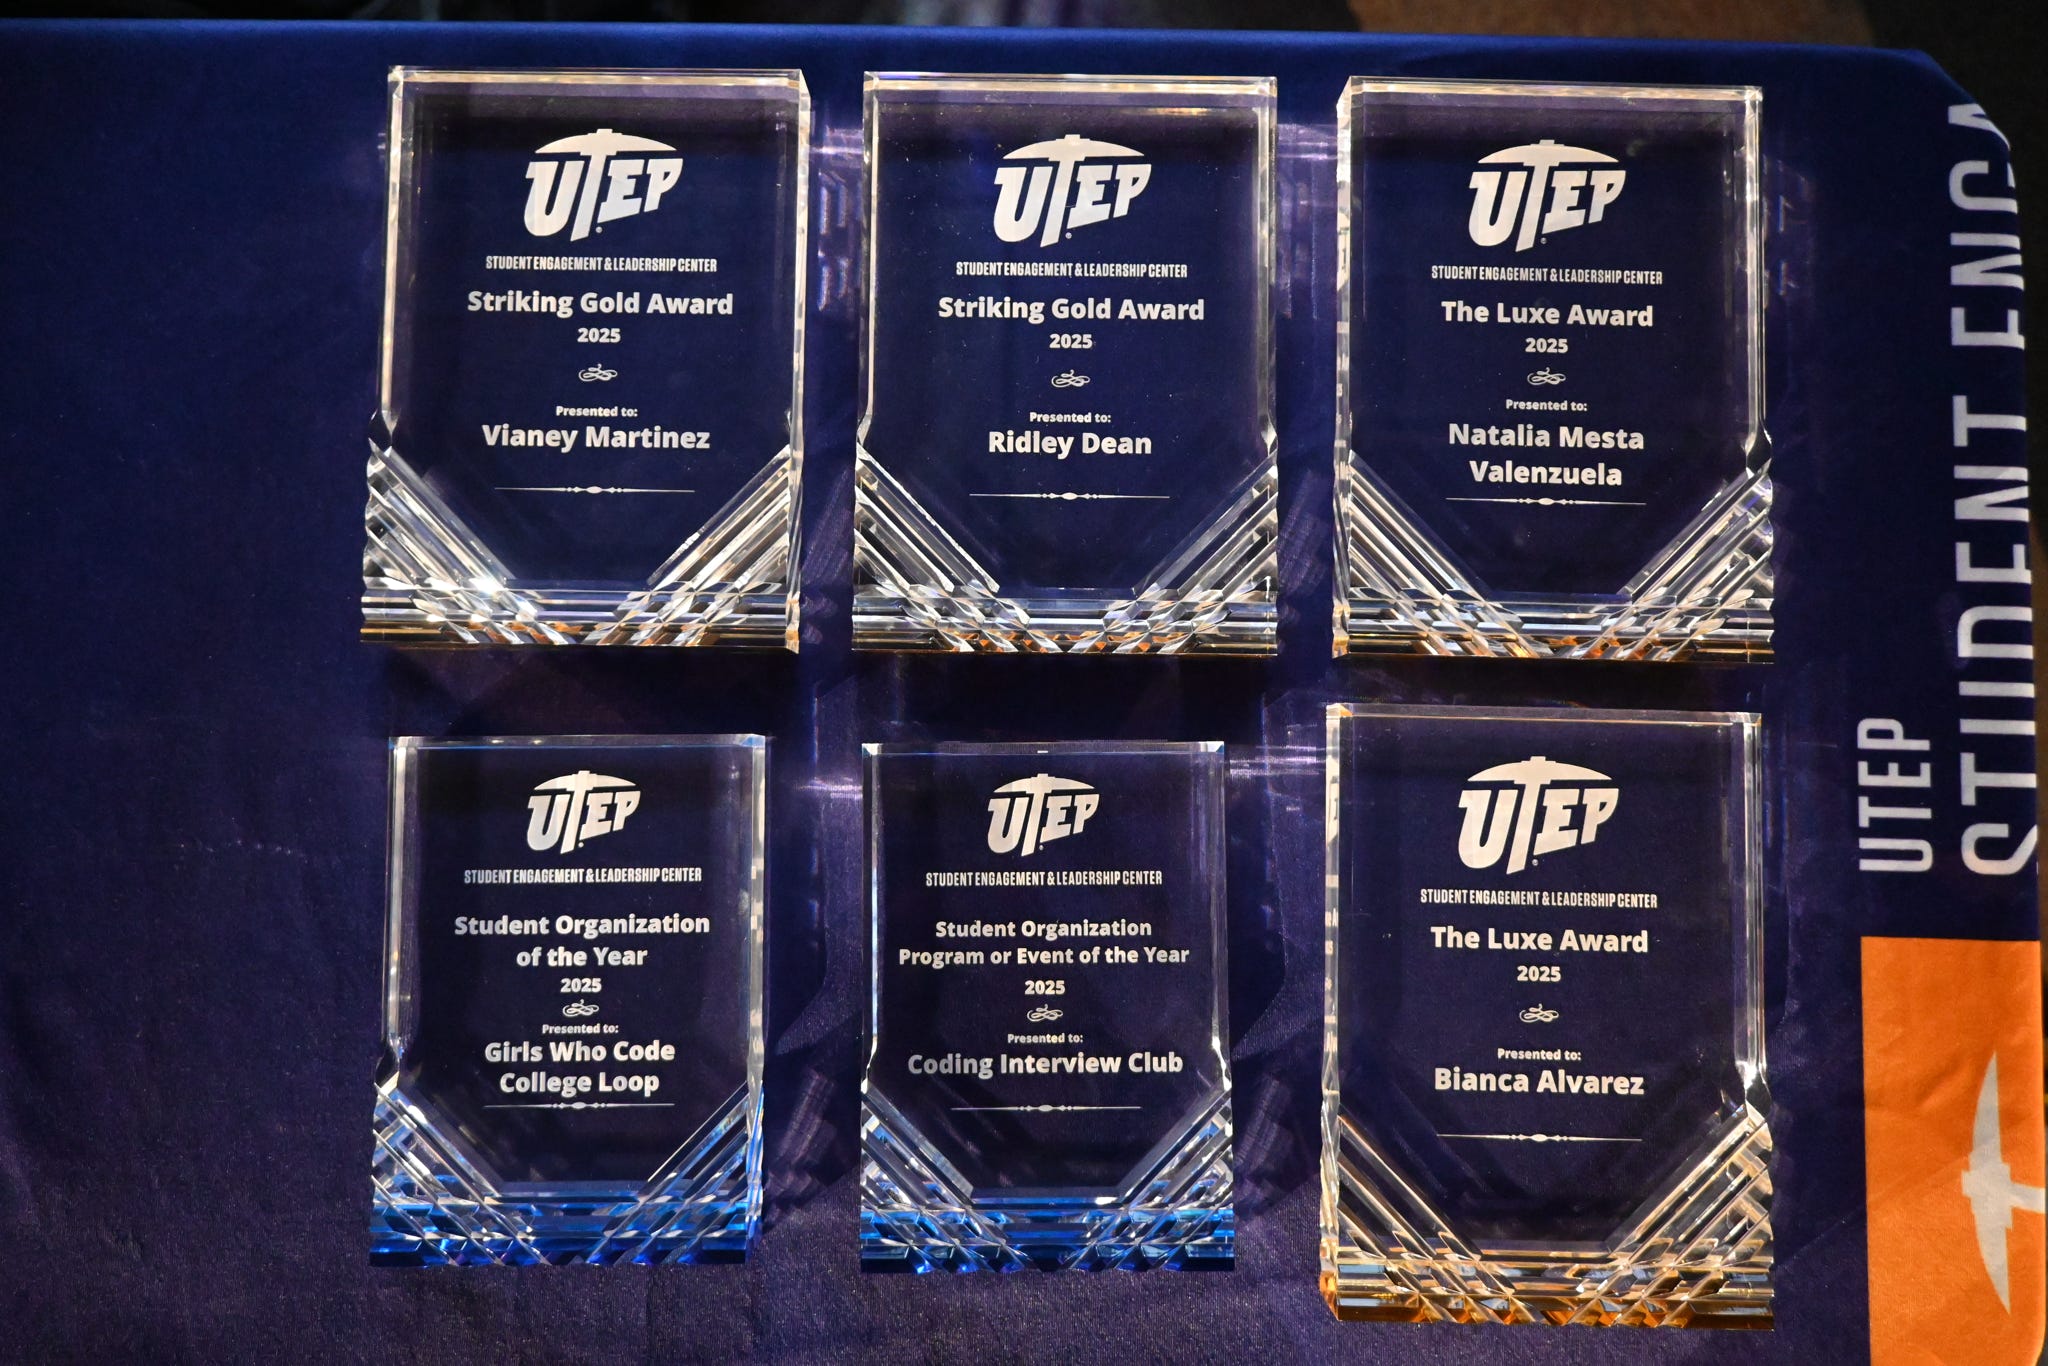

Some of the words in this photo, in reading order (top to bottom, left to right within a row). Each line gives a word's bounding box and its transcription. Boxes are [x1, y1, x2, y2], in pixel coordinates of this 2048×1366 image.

[522, 129, 684, 241] UTEP
[992, 134, 1153, 247] UTEP
[1467, 140, 1627, 252] UTEP
[485, 256, 533, 269] STUDENT
[533, 256, 604, 270] ENGAGEMENT
[604, 257, 612, 270] &
[613, 257, 677, 271] LEADERSHIP
[678, 258, 718, 272] CENTER
[955, 262, 1004, 276] STUDENT
[1004, 262, 1074, 278] ENGAGEMENT
[1074, 263, 1083, 276] &
[1084, 263, 1147, 277] LEADERSHIP
[1148, 264, 1189, 278] CENTER
[1431, 265, 1478, 279] STUDENT
[1479, 267, 1549, 281] ENGAGEMENT
[1549, 269, 1558, 281] &
[1559, 269, 1623, 283] LEADERSHIP
[1623, 271, 1663, 284] CENTER
[466, 290, 574, 318] Striking
[580, 292, 640, 313] Gold
[646, 293, 734, 314] Award
[938, 294, 1045, 324] Striking
[1051, 298, 1112, 319] Gold
[1118, 299, 1205, 320] Award
[1440, 301, 1490, 322] The
[1497, 303, 1560, 324] Luxe
[1566, 305, 1654, 326] Award
[576, 328, 622, 343] 2025
[1048, 334, 1094, 348] 2025
[1524, 338, 1569, 353] 2025
[555, 406, 619, 417] Presented
[620, 408, 639, 417] to:
[1505, 399, 1569, 410] Presented
[1570, 402, 1588, 411] to:
[1028, 412, 1092, 424] Presented
[1094, 414, 1112, 423] to:
[481, 423, 579, 453] Vianey
[585, 426, 711, 448] Martinez
[987, 430, 1075, 459] Ridley
[1081, 433, 1153, 454] Dean
[1448, 424, 1552, 446] Natalia
[1559, 427, 1645, 449] Mesta
[1469, 460, 1623, 485] Valenzuela
[1857, 717, 1933, 873] UTEP
[526, 771, 642, 854] UTEP
[986, 774, 1101, 856] UTEP
[1456, 756, 1620, 874] UTEP
[463, 870, 513, 883] STUDENT
[513, 869, 585, 883] ENGAGEMENT
[585, 869, 595, 882] &
[595, 868, 661, 882] LEADERSHIP
[661, 868, 702, 882] CENTER
[925, 872, 974, 886] STUDENT
[975, 872, 1045, 886] ENGAGEMENT
[1047, 872, 1056, 885] &
[1056, 871, 1122, 885] LEADERSHIP
[1122, 871, 1163, 884] CENTER
[1420, 889, 1468, 903] STUDENT
[1469, 890, 1541, 905] ENGAGEMENT
[1541, 892, 1551, 905] &
[1551, 892, 1617, 907] LEADERSHIP
[1617, 893, 1658, 908] CENTER
[454, 915, 550, 934] Student
[555, 913, 711, 939] Organization
[935, 920, 1016, 937] Student
[1021, 919, 1153, 941] Organization
[1430, 926, 1480, 949] The
[1488, 928, 1553, 950] Luxe
[1559, 930, 1649, 952] Award
[516, 947, 542, 966] of
[547, 946, 587, 966] the
[593, 947, 649, 965] Year
[898, 949, 985, 969] Program
[990, 951, 1011, 964] or
[1017, 948, 1074, 964] Event
[1079, 947, 1101, 963] of
[1104, 946, 1139, 963] the
[1143, 947, 1190, 962] Year
[559, 978, 602, 992] 2025
[1516, 966, 1562, 982] 2025
[1024, 980, 1066, 995] 2025
[542, 1023, 601, 1034] Presented
[602, 1024, 619, 1033] to:
[1007, 1033, 1066, 1043] Presented
[1067, 1034, 1084, 1043] to:
[484, 1041, 543, 1062] Girls
[549, 1041, 608, 1061] Who
[613, 1040, 676, 1061] Code
[1497, 1048, 1563, 1060] Presented
[1564, 1051, 1582, 1060] to:
[907, 1054, 993, 1079] Coding
[999, 1052, 1122, 1073] Interview
[1128, 1052, 1184, 1072] Club
[499, 1072, 592, 1097] College
[599, 1072, 660, 1097] Loop
[1434, 1066, 1530, 1092] Bianca
[1536, 1069, 1645, 1094] Alvarez
